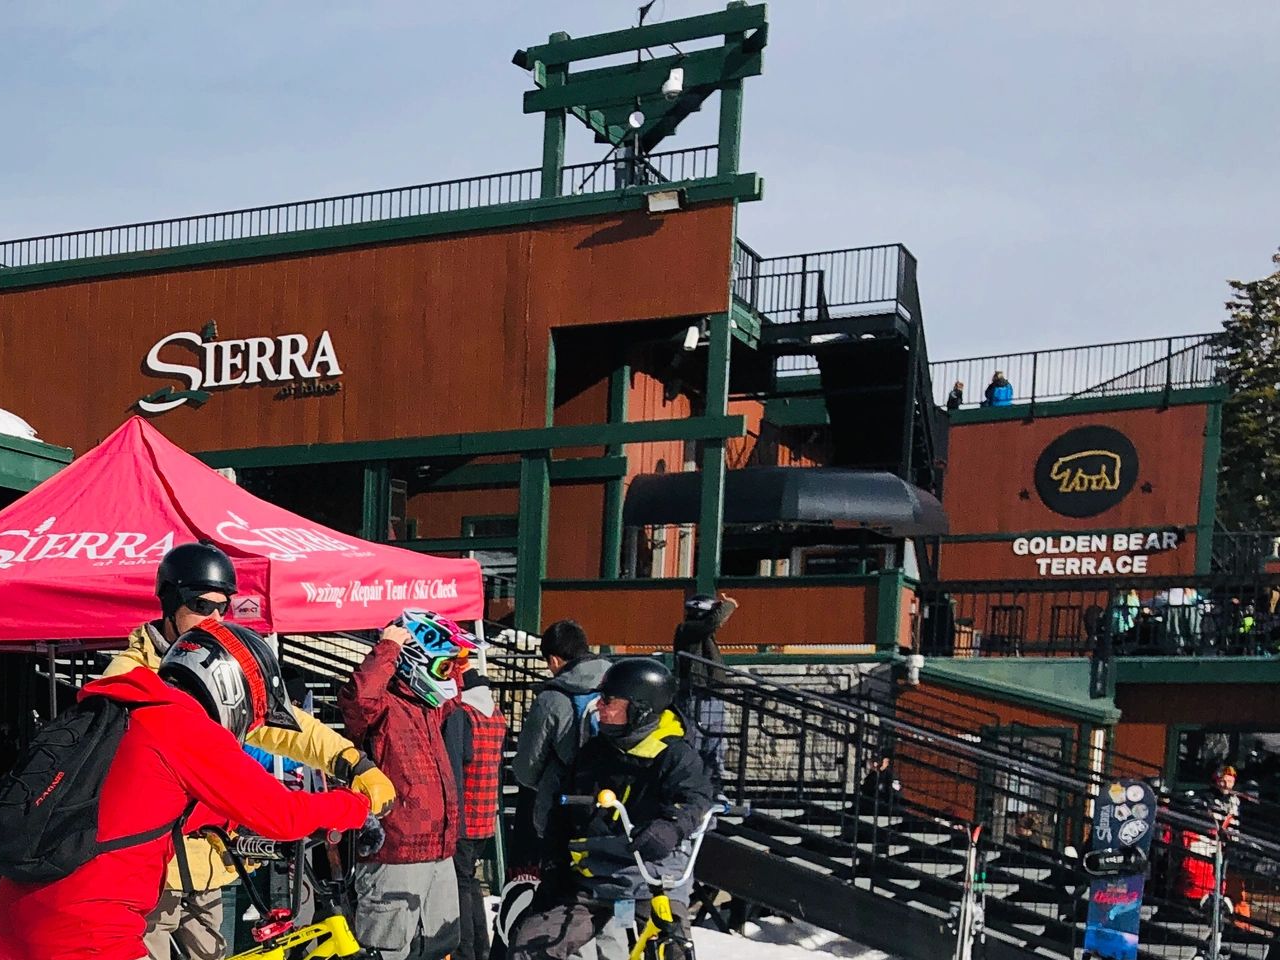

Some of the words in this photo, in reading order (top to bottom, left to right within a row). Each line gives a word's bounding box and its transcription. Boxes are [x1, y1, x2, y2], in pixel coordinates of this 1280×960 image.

[138, 330, 343, 413] SIERRA
[1012, 534, 1107, 556] GOLDEN
[1113, 533, 1178, 552] BEAR
[1035, 555, 1149, 576] TERRACE
[350, 580, 383, 607] Repair
[385, 579, 408, 600] Tent
[413, 579, 429, 600] Ski
[429, 578, 458, 600] Check
[414, 622, 448, 649] FOX
